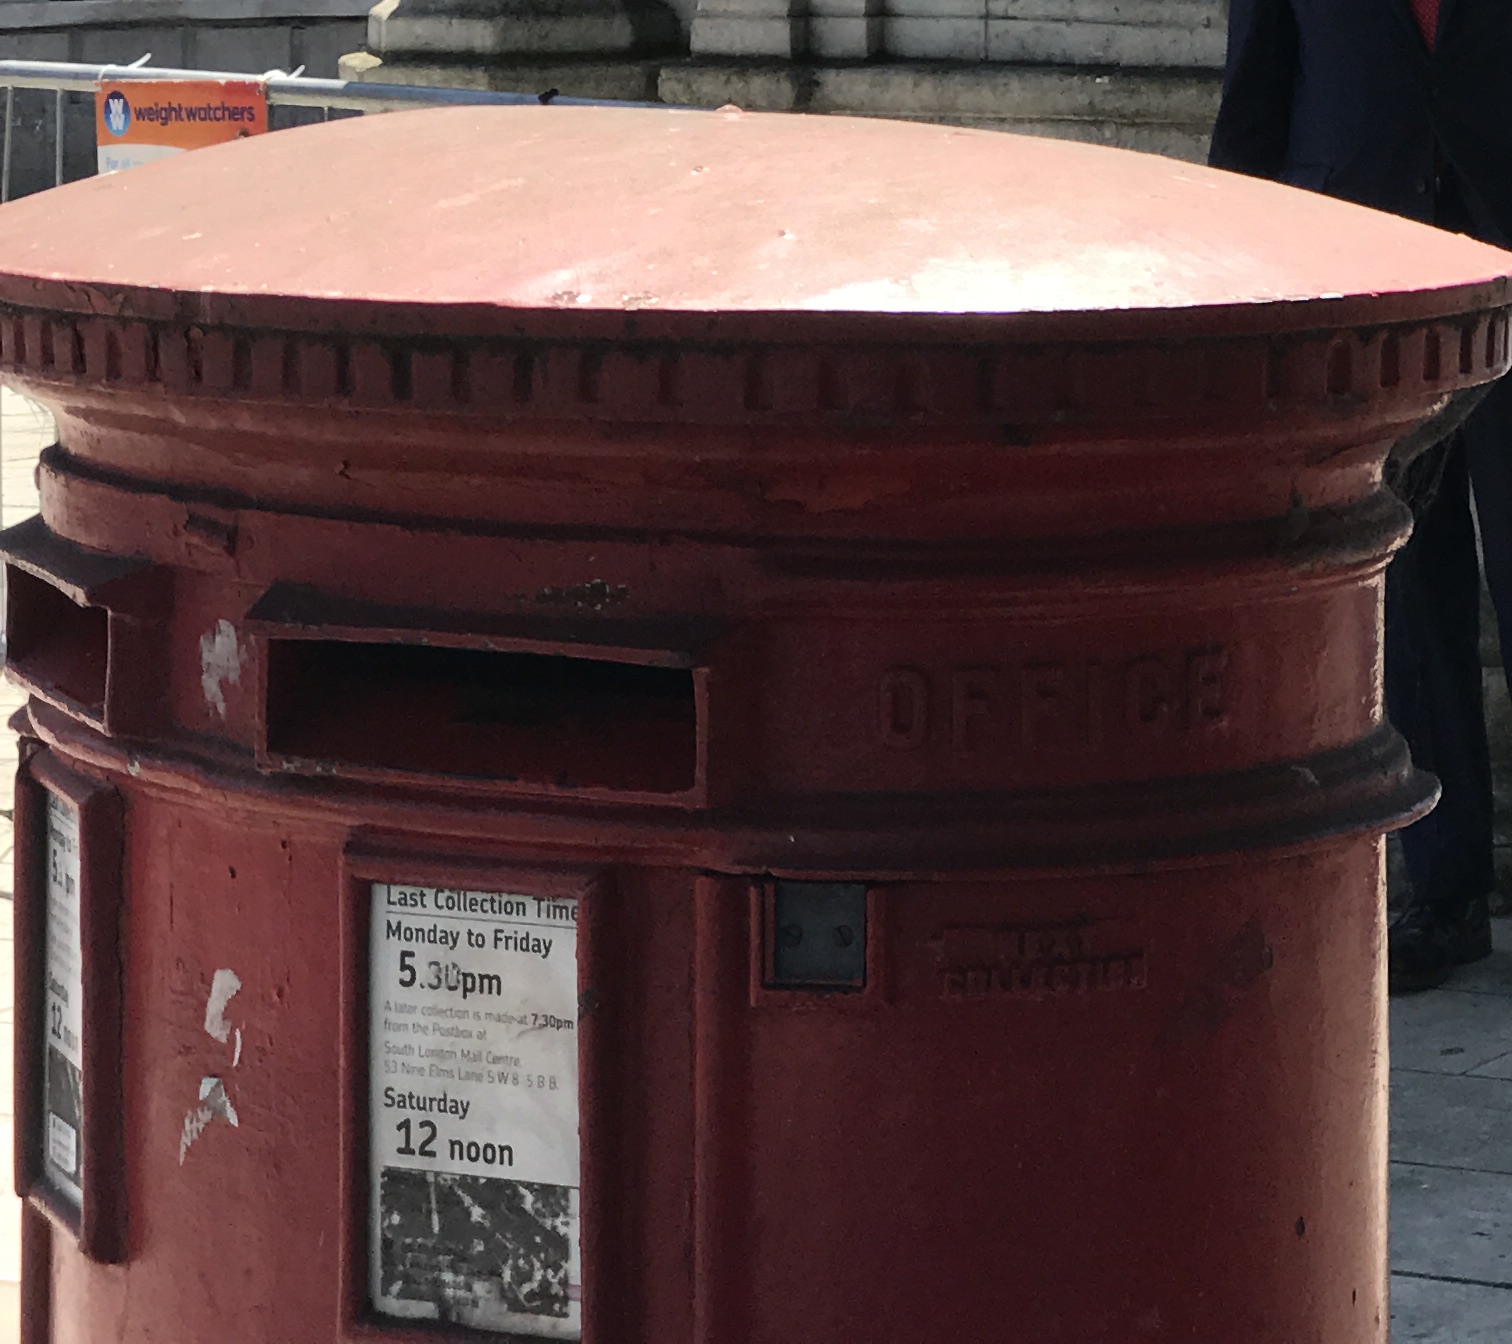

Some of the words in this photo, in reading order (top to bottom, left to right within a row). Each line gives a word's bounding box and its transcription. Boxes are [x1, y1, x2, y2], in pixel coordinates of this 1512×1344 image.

[879, 641, 1231, 753] OFFICE
[386, 884, 427, 909] Last
[434, 887, 527, 917] Collection
[386, 919, 460, 950] Monday
[466, 928, 486, 948] to
[493, 928, 553, 959] Friday
[398, 949, 502, 1000] 5.30pm
[383, 999, 392, 1012] A
[421, 1004, 470, 1020] collection
[531, 1012, 574, 1031] 7.30pm
[384, 1017, 409, 1033] from
[412, 1022, 428, 1035] the
[384, 1040, 415, 1056] South
[383, 1086, 470, 1119] Saturday
[395, 1117, 438, 1159] 12
[448, 1140, 514, 1167] noon
